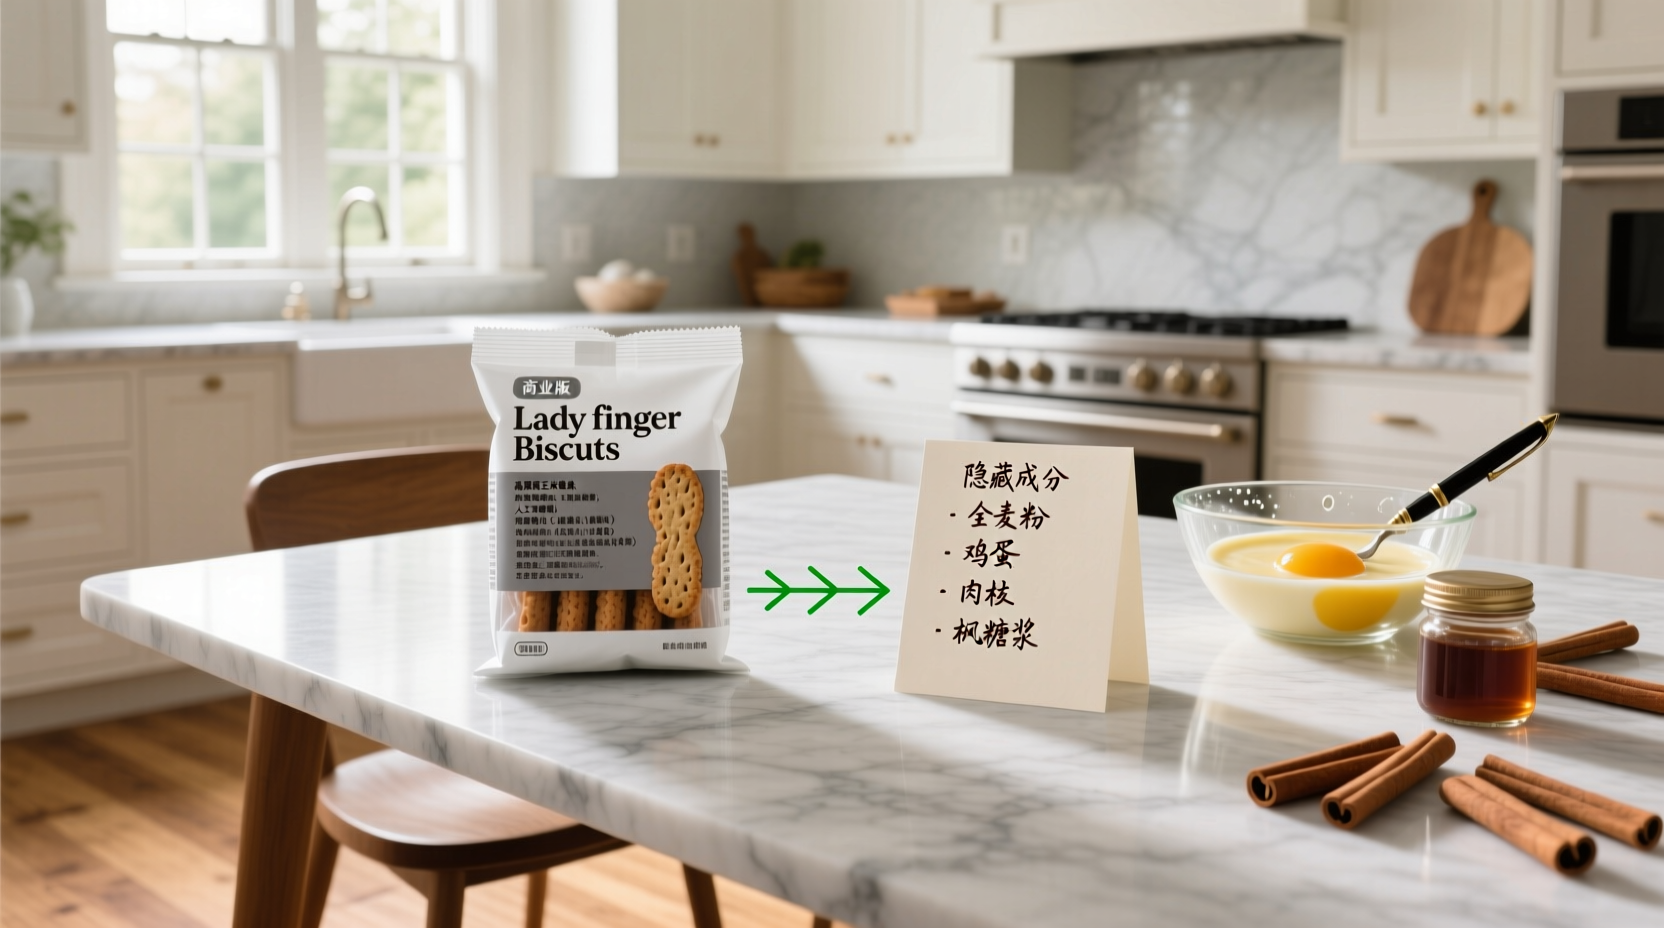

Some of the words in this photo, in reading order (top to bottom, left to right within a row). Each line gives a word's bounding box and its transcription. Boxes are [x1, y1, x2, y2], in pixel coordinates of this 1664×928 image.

[513, 404, 587, 439] Lady
[591, 403, 682, 439] finger
[513, 435, 620, 462] Biscuts
[963, 460, 1070, 493] 隐藏成分
[967, 500, 1051, 530] 全麦粉
[963, 538, 1021, 569] 鸡蛋
[952, 617, 1039, 651] 枫糖浆
